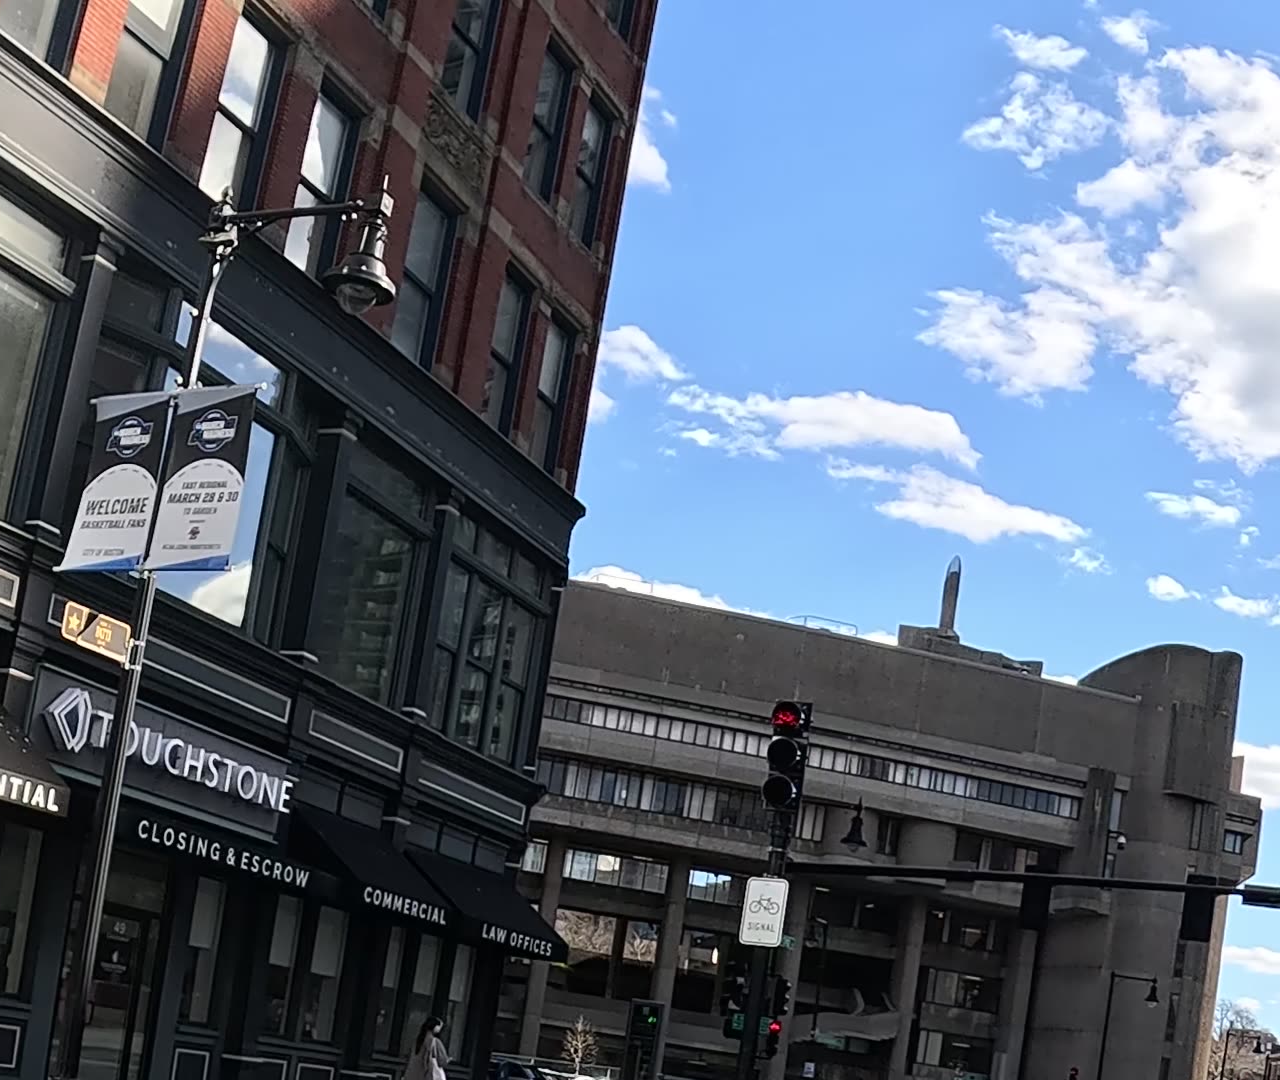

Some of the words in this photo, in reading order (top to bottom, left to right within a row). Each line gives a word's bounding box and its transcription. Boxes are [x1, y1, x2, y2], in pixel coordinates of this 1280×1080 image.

[85, 497, 149, 516] WELCOME
[167, 492, 201, 504] MARCH
[202, 491, 216, 503] 28
[225, 490, 239, 502] 30
[80, 519, 125, 529] BASKETBALL
[126, 518, 147, 528] FANS
[138, 819, 220, 861] CLOSING
[226, 847, 237, 867] &
[240, 851, 311, 888] ESCROW
[363, 886, 447, 925] COMMERCIAL
[747, 921, 775, 933] SIGNAL
[482, 923, 508, 944] LAW
[509, 932, 553, 957] OFFICES
